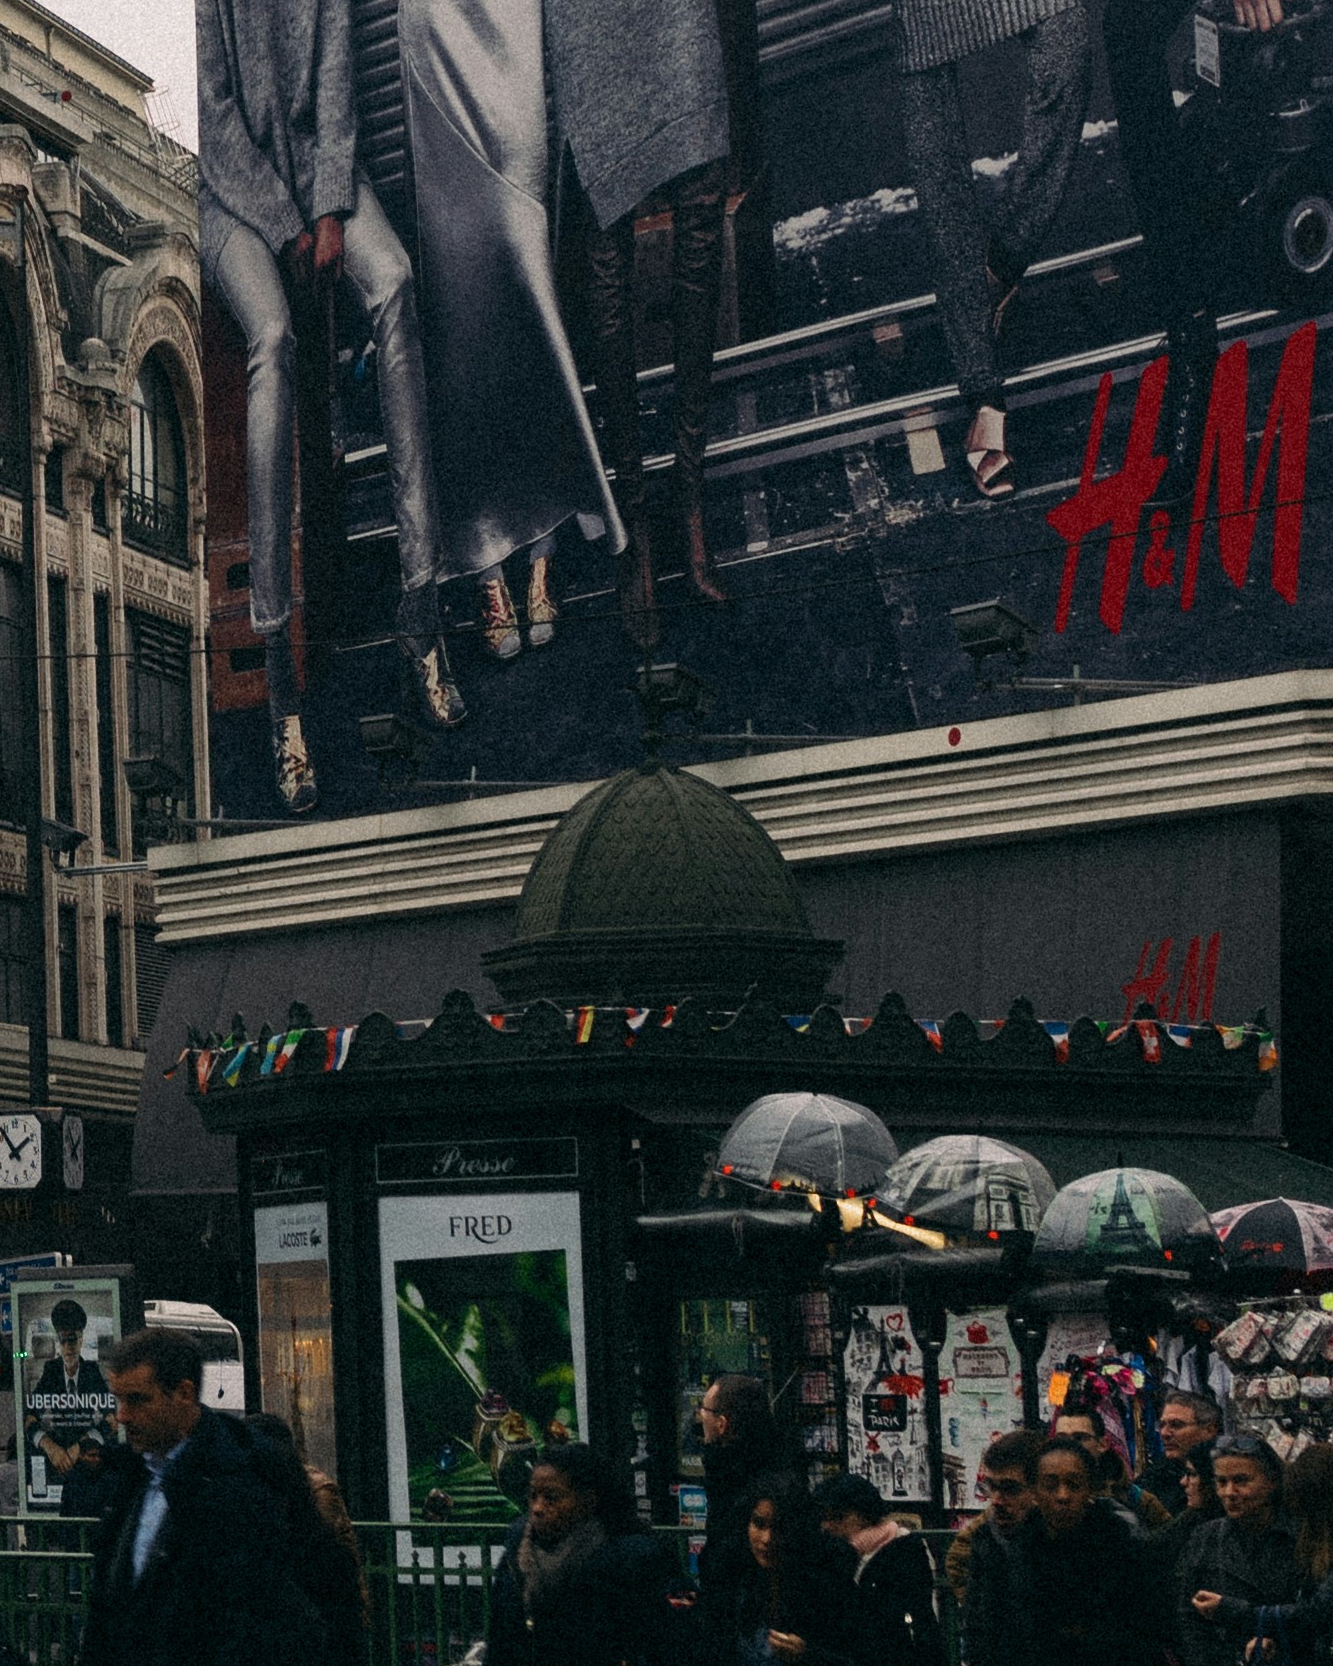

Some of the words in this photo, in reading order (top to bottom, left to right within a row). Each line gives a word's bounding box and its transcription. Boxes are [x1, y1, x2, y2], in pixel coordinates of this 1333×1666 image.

[1045, 320, 1318, 635] H&M
[431, 1146, 517, 1175] Presse
[278, 1231, 308, 1248] LACOSTE
[449, 1215, 514, 1244] FRED
[25, 1392, 116, 1410] UBERSONIQUE
